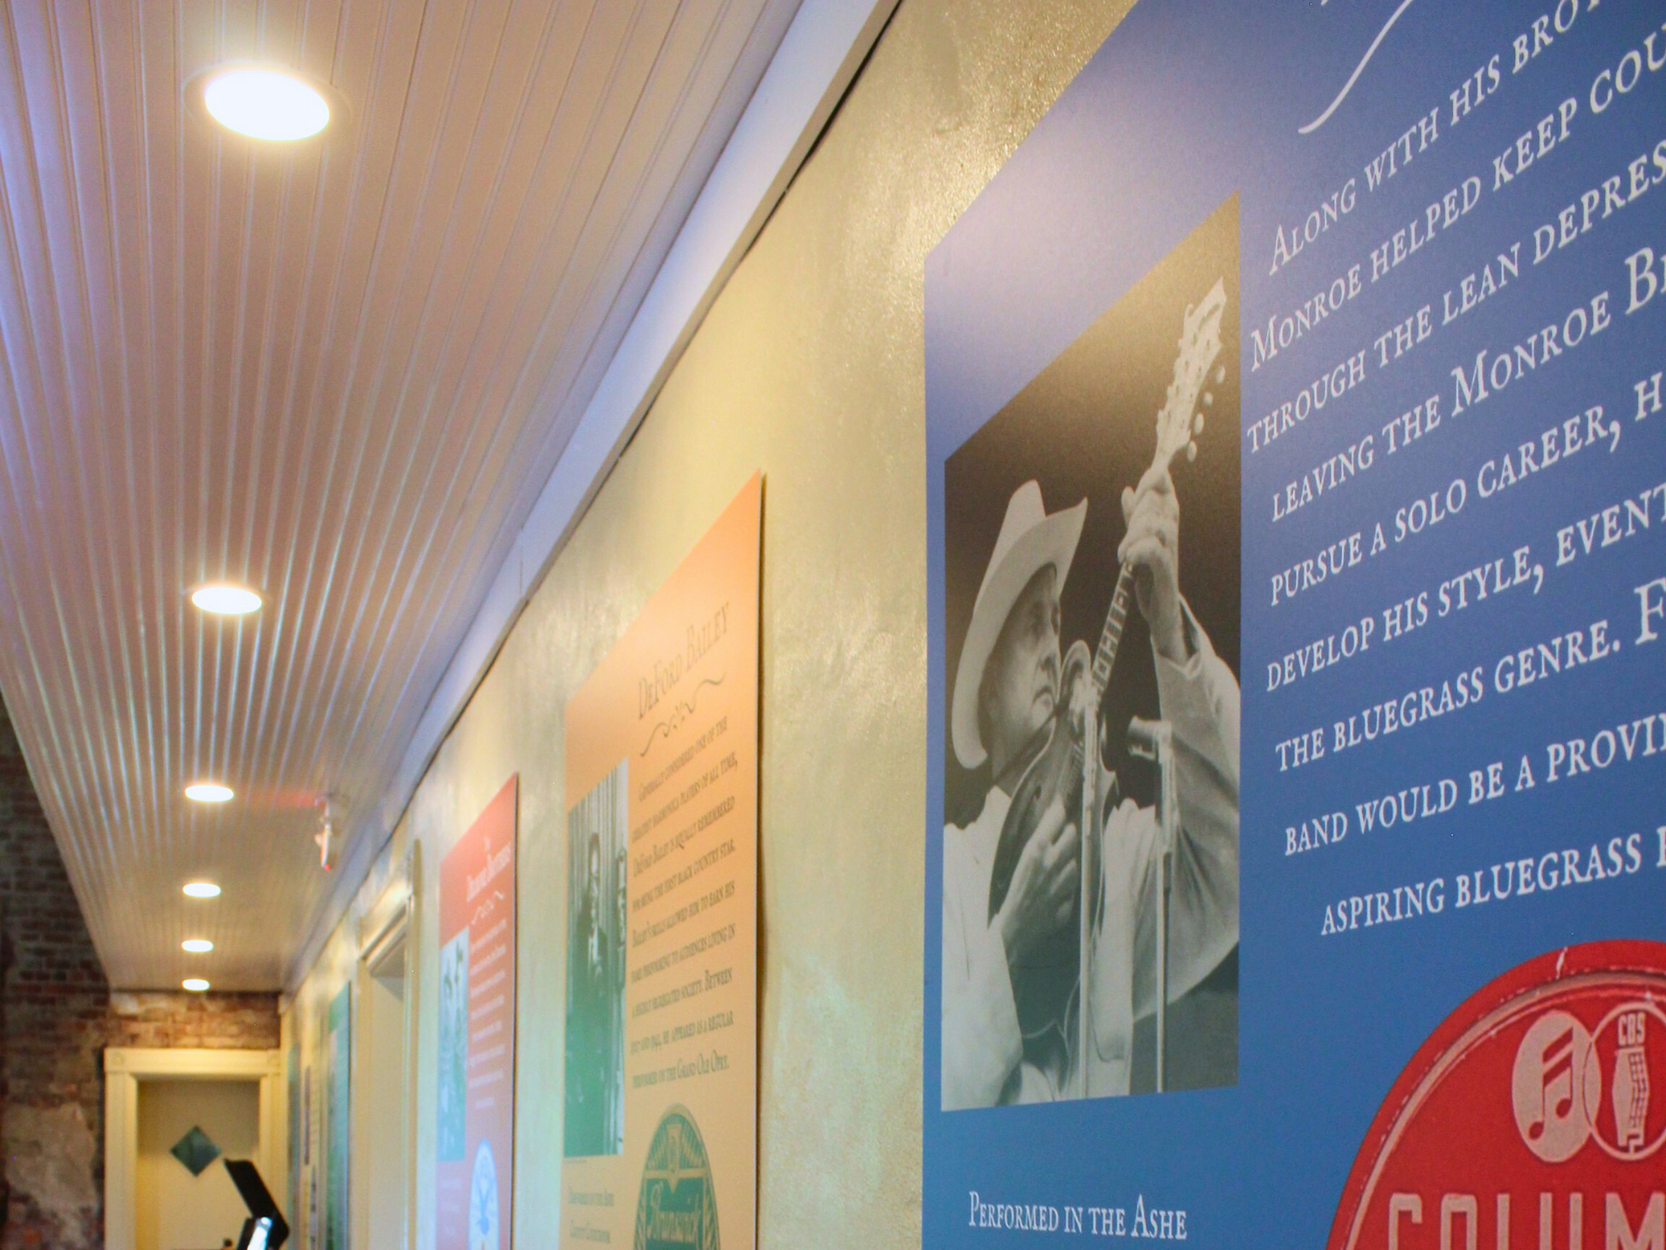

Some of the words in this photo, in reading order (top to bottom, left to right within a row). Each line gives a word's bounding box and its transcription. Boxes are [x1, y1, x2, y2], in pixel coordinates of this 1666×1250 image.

[1269, 179, 1356, 276] ALONG
[1364, 107, 1439, 192] WITH
[1450, 54, 1500, 126] HIS
[1512, 0, 1600, 74] BRO
[1250, 263, 1361, 372] MONROE
[1370, 175, 1482, 284] HELPED
[1492, 97, 1577, 192] KEEP
[1247, 350, 1366, 453] THROUGH
[1374, 305, 1432, 368] THE
[1442, 242, 1520, 325] LEAN
[1272, 436, 1374, 522] LEAVING
[1382, 394, 1440, 455] THE
[1450, 291, 1610, 417] MONROE
[1270, 532, 1362, 606] PURSUE
[1370, 522, 1387, 556] A
[1394, 478, 1467, 543] SOLO
[1477, 405, 1621, 499] CAREER,
[1266, 617, 1374, 692] DEVELOP
[1382, 591, 1428, 642] HIS
[1437, 545, 1545, 617] STYLE,
[1275, 729, 1325, 772] THE
[1333, 667, 1484, 753] BLUEGRASS
[1494, 620, 1620, 693] GENRE.
[1285, 811, 1348, 856] BAND
[1356, 778, 1458, 835] WOULD
[1468, 762, 1504, 805] BE
[1514, 754, 1536, 791] A
[1321, 878, 1445, 936] ASPIRING
[1455, 832, 1642, 908] BLUEGRASS
[704, 967, 733, 991] BETWEEN
[1617, 1012, 1647, 1047] CBS
[969, 1191, 1059, 1233] PERFORMED
[1064, 1206, 1083, 1234] IN
[1088, 1208, 1126, 1236] THE
[1131, 1194, 1187, 1240] ASHE
